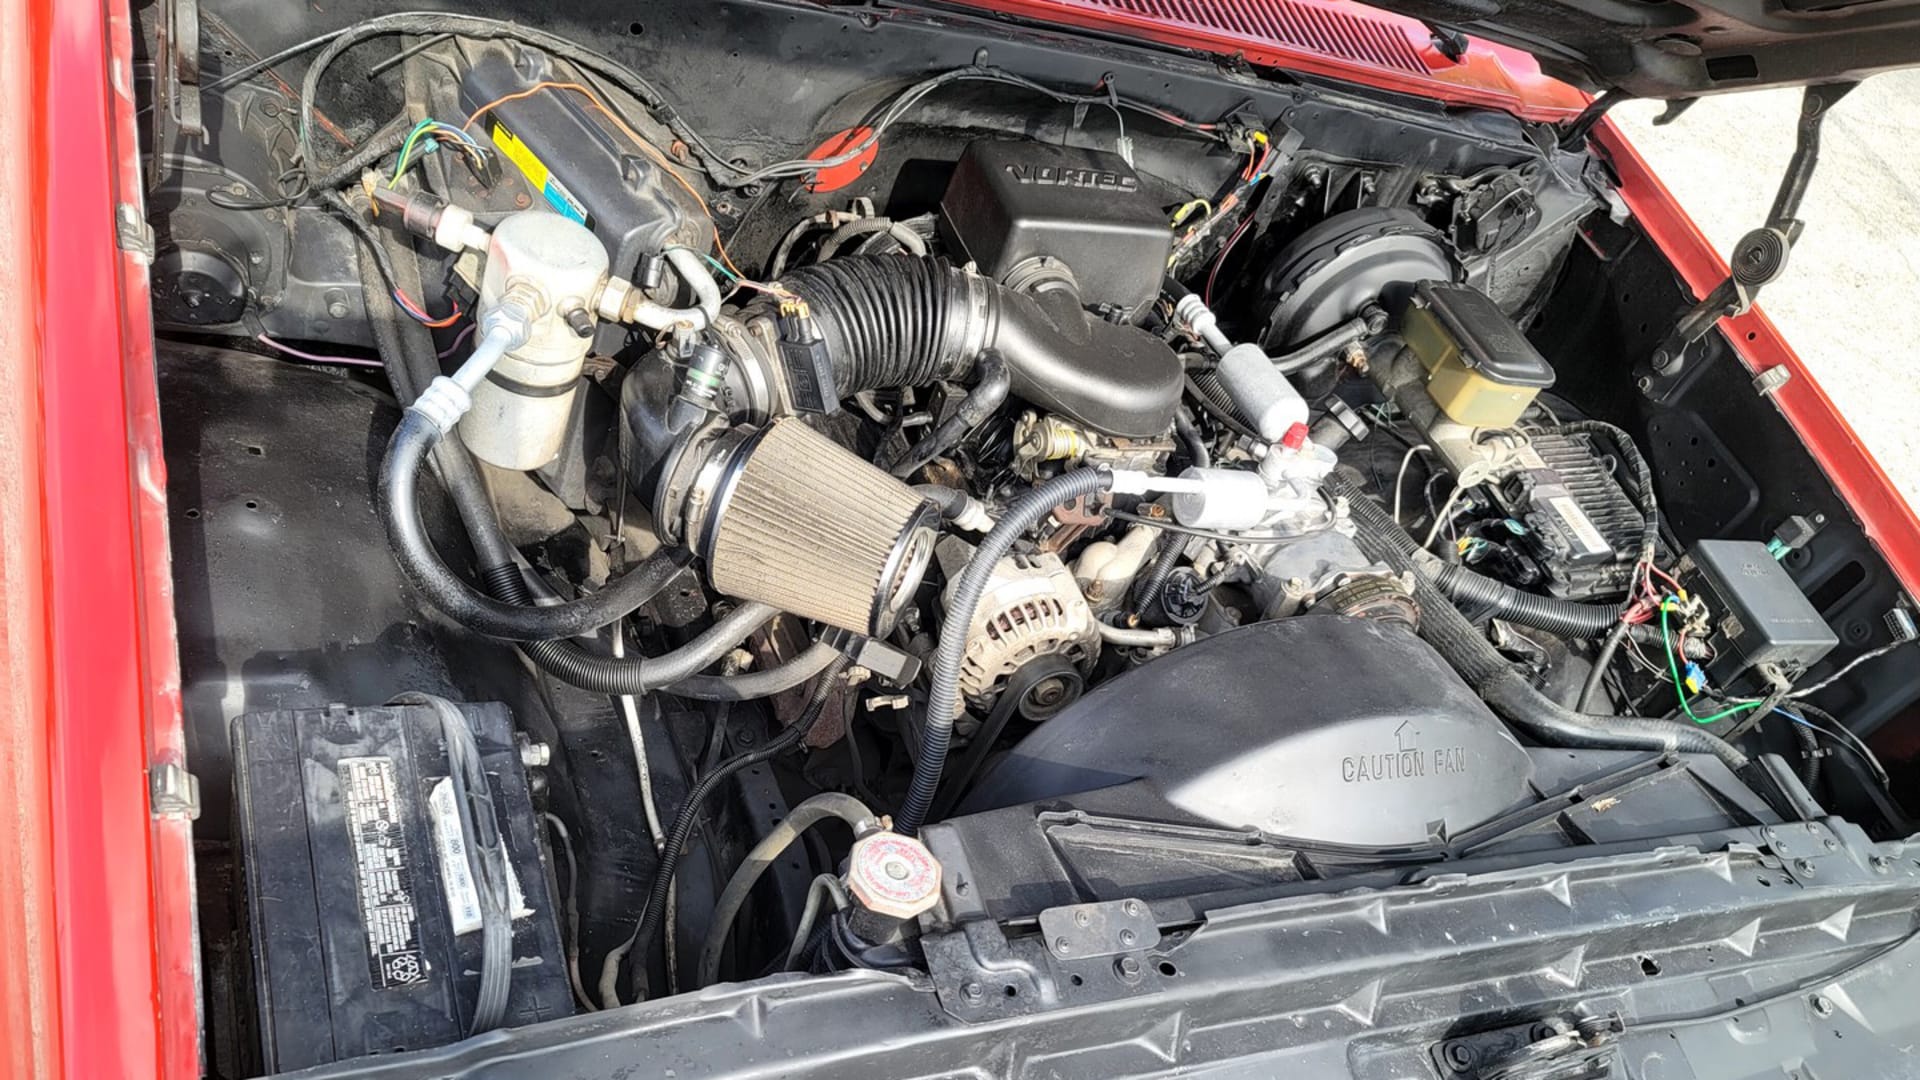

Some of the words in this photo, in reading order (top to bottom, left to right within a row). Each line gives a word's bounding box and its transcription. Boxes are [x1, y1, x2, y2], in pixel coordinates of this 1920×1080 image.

[1005, 163, 1137, 193] VORTEC
[1341, 751, 1425, 783] CAUTION
[1433, 747, 1465, 775] FAN
